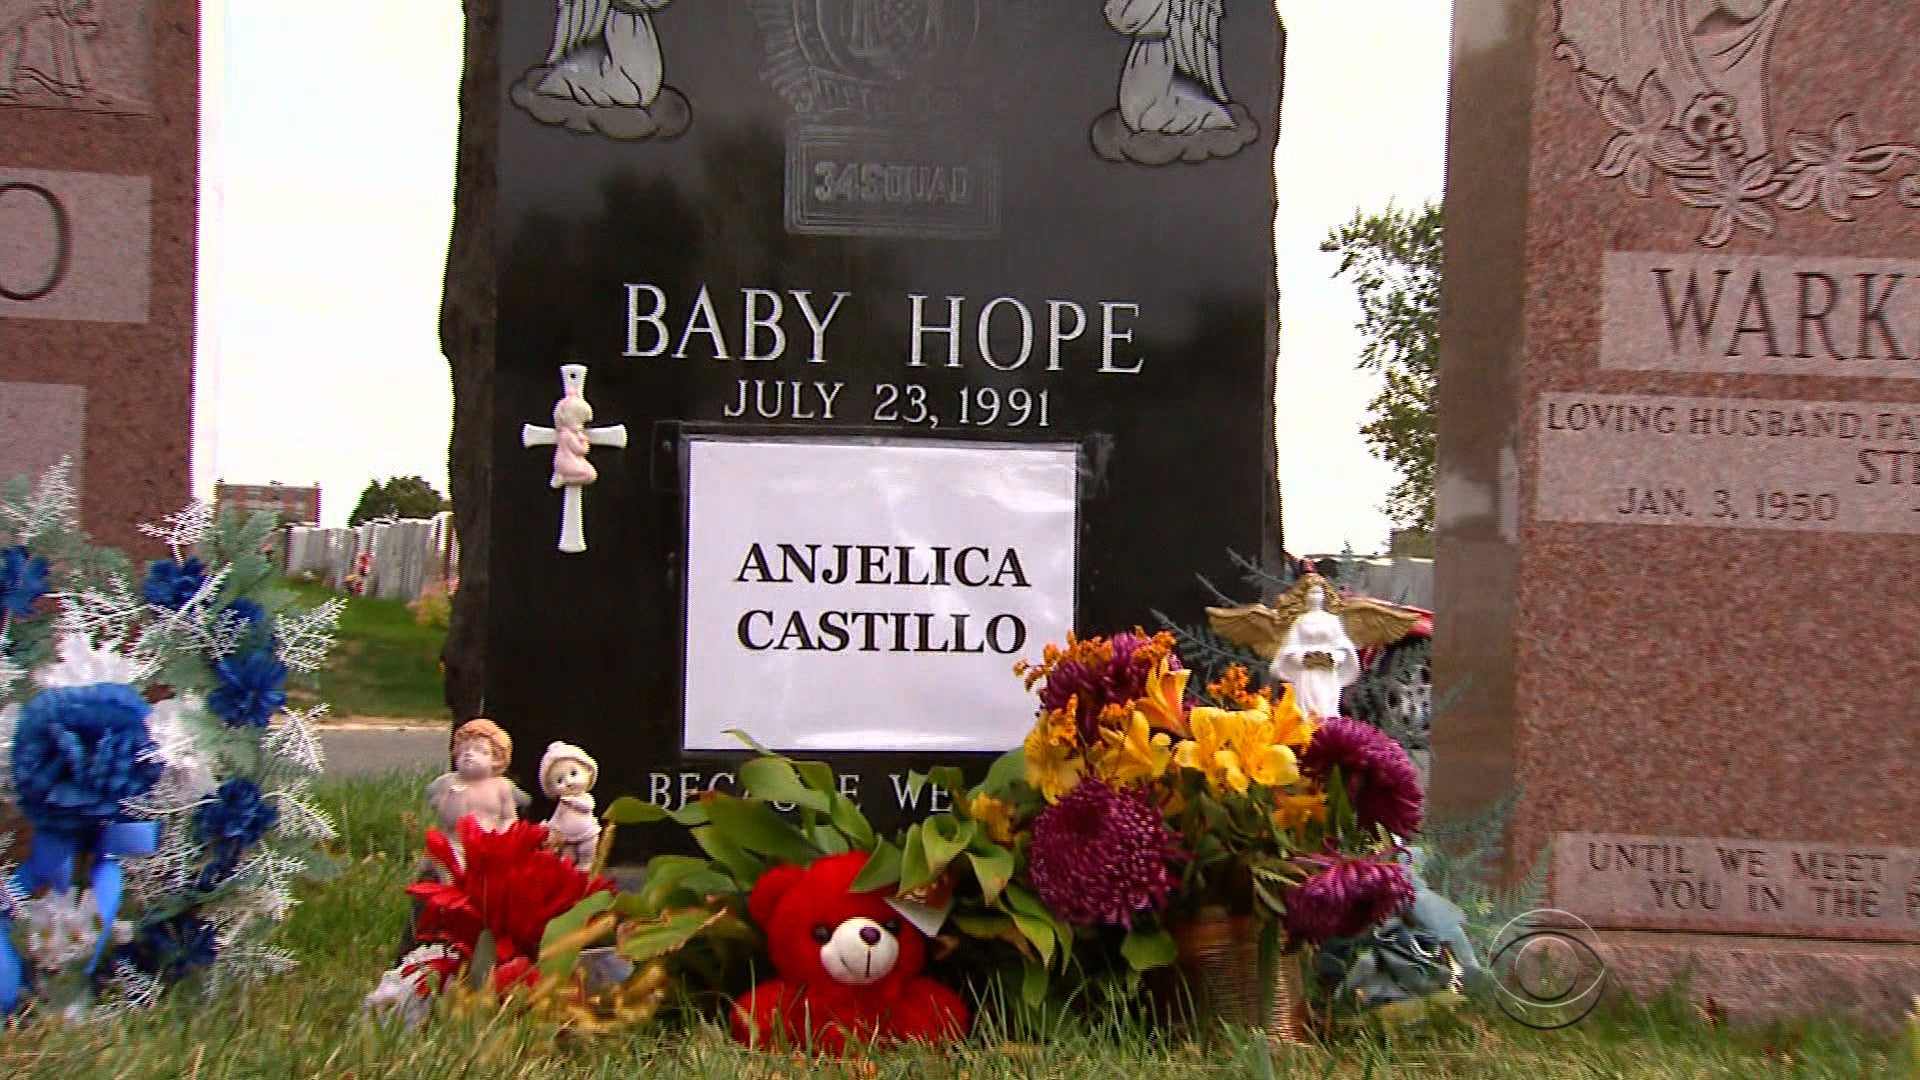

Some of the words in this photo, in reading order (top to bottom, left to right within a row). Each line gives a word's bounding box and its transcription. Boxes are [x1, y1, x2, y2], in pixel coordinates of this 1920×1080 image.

[621, 282, 851, 363] BABY
[906, 294, 1145, 375] HOPE
[1651, 267, 1920, 362] WARK
[723, 379, 844, 420] JULY
[872, 383, 940, 429] 23,
[958, 387, 1051, 428] 1991
[1547, 402, 1677, 435] LOVING
[1875, 412, 1920, 441] FA
[1616, 487, 1693, 519] JAN.
[1755, 491, 1841, 522] 1950
[736, 542, 1032, 588] ANJELICA
[736, 609, 1028, 655] CASTILLO
[1588, 842, 1695, 874] UNTIL
[1714, 847, 1769, 878] WE
[1790, 850, 1890, 883] MEET
[1647, 878, 1723, 911] YOU
[1746, 883, 1786, 912] IN
[1807, 886, 1882, 918] THE
